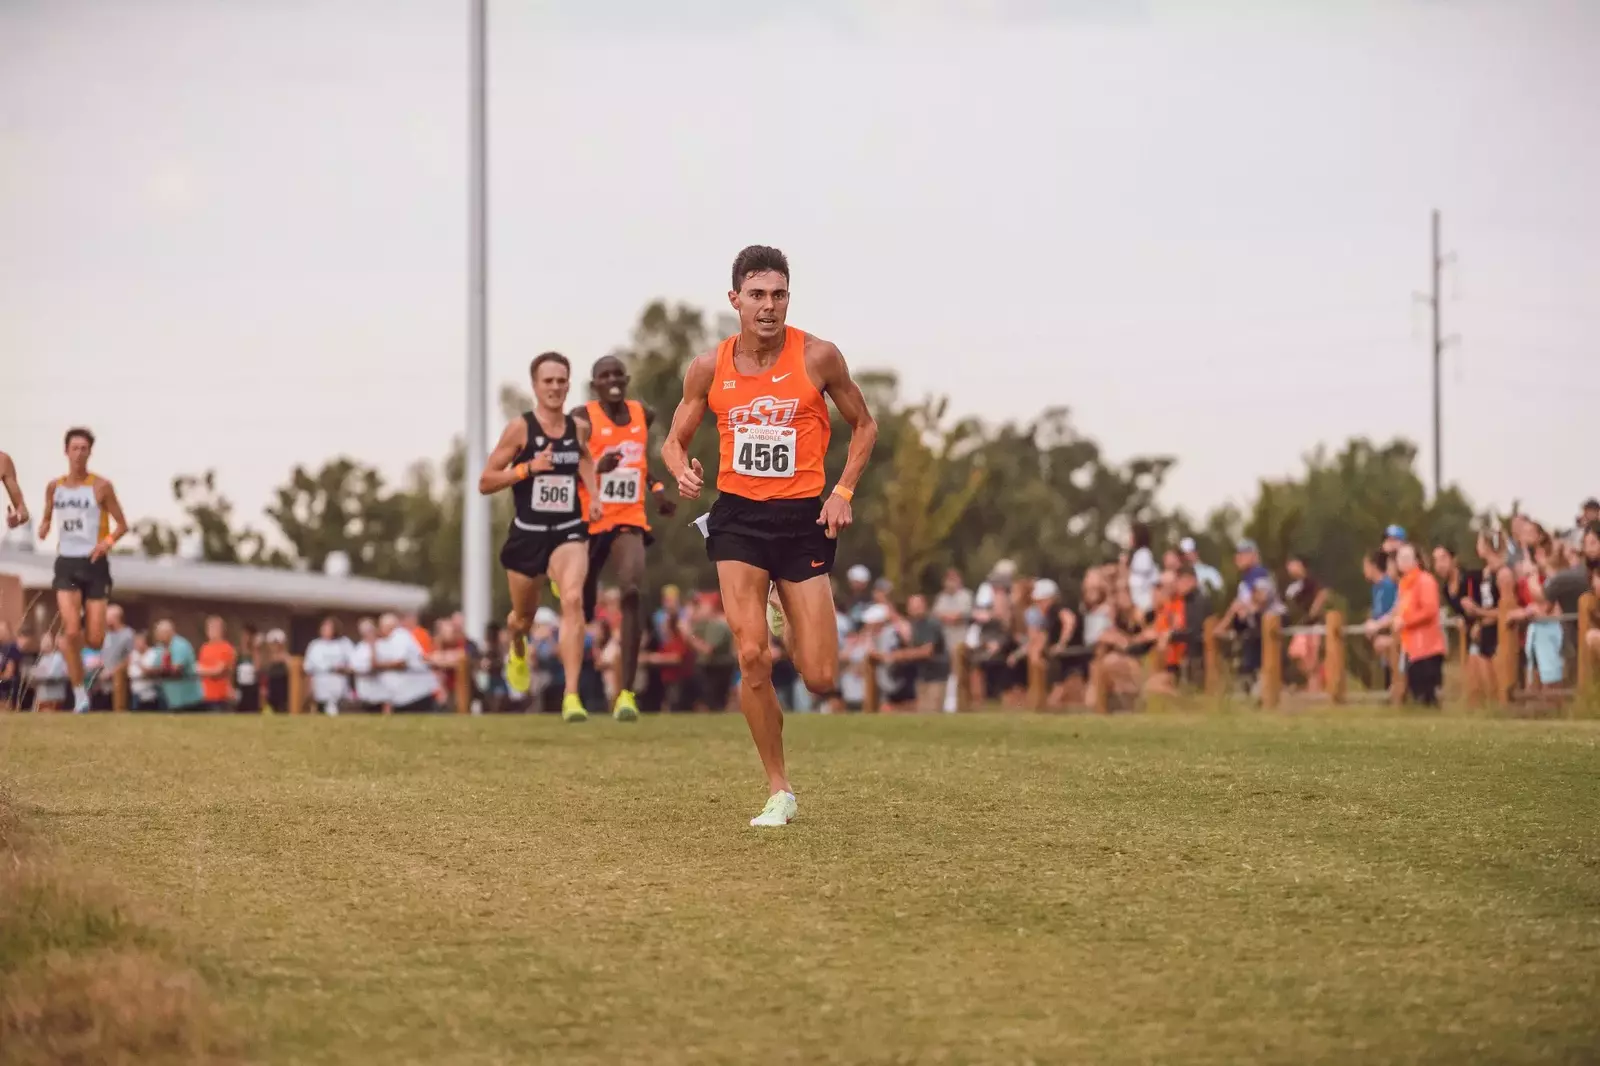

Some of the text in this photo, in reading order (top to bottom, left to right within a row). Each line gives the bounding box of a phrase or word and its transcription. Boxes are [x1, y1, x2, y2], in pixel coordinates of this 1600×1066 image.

[729, 396, 798, 427] OSU
[738, 442, 789, 472] 456
[540, 486, 569, 503] 506
[604, 480, 636, 499] 449
